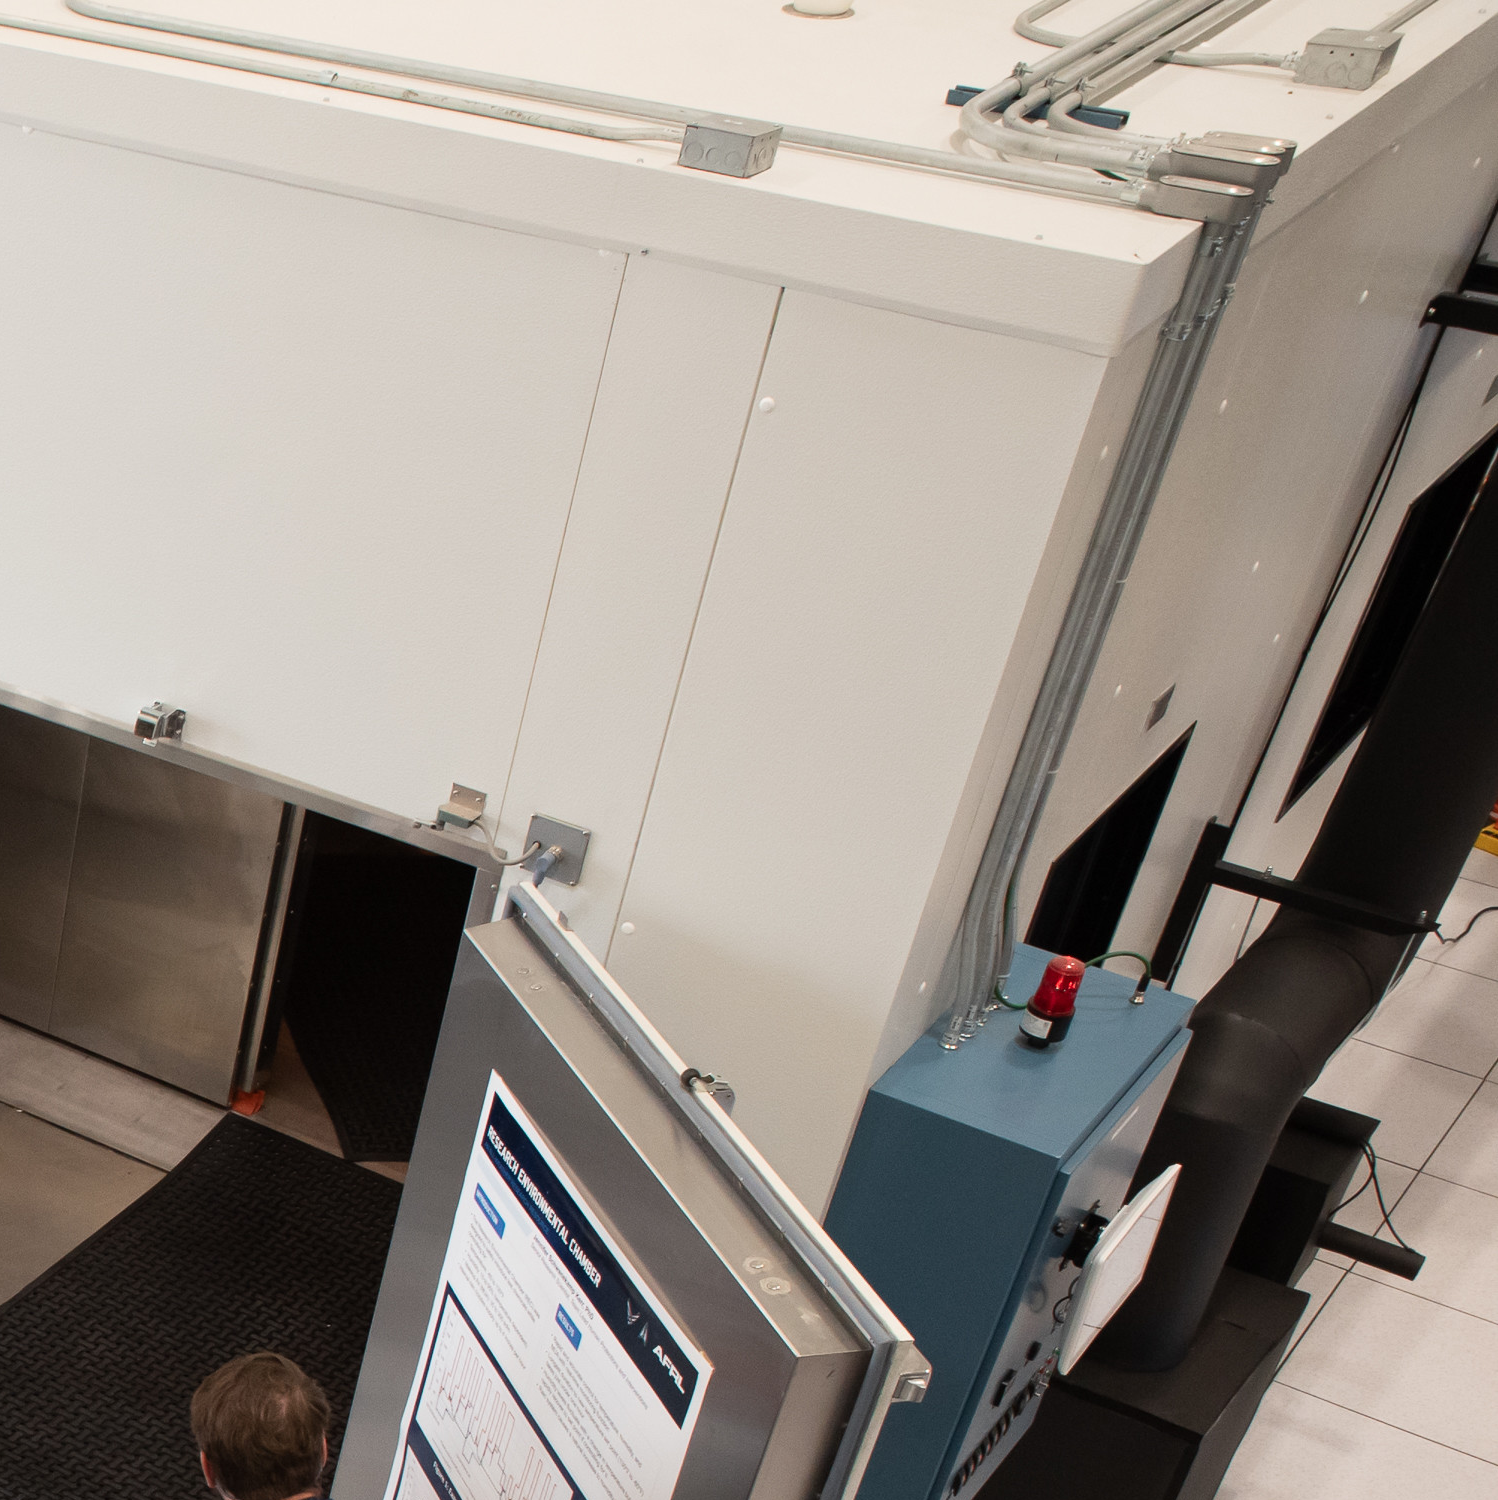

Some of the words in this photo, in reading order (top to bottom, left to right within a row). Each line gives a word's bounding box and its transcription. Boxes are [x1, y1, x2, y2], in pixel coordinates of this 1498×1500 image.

[486, 1124, 520, 1175] RESEARCH
[516, 1167, 571, 1245] ENVIRONMENTAL
[567, 1237, 602, 1288] CHAMBER
[651, 1339, 689, 1394] AFRL
